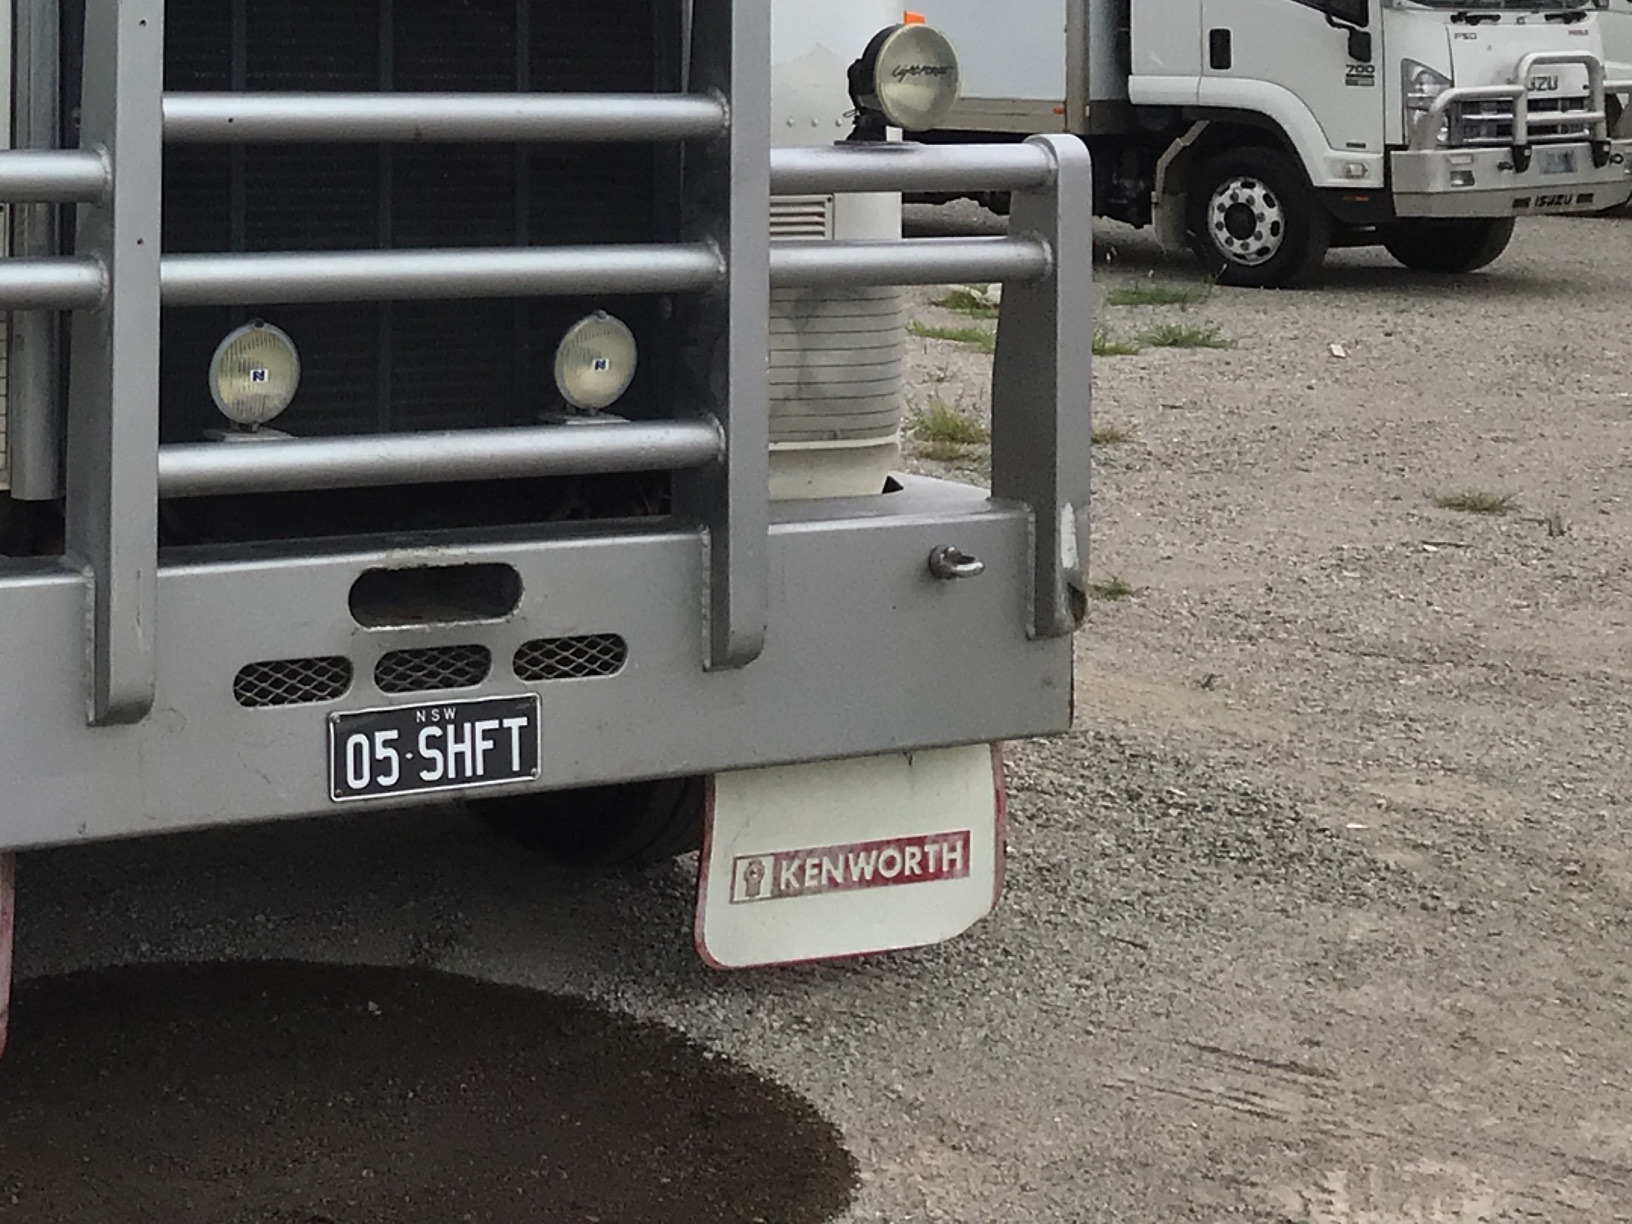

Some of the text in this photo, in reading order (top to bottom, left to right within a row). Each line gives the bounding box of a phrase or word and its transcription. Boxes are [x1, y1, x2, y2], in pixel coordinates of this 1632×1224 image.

[1345, 64, 1375, 73] 700
[1534, 193, 1573, 208] ISUZU
[416, 707, 457, 723] NSW
[779, 839, 964, 891] KENWORTH
